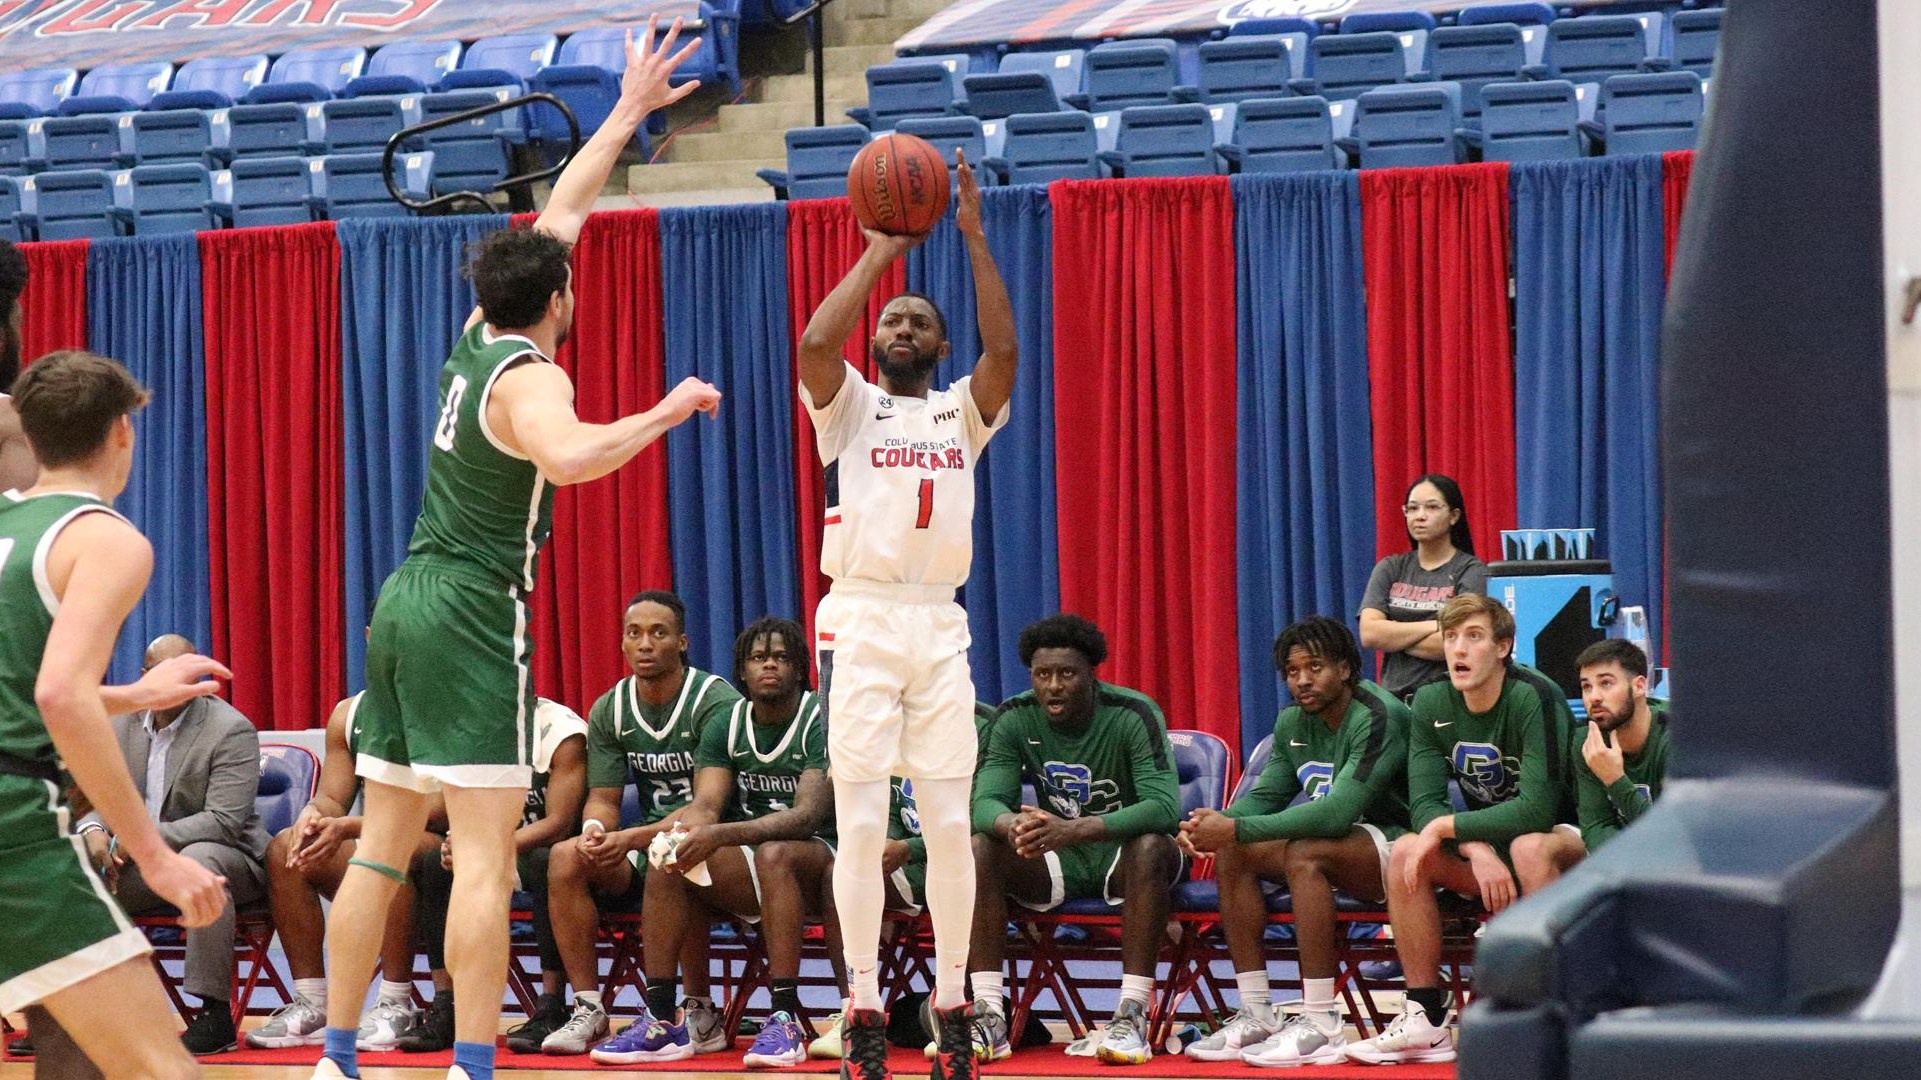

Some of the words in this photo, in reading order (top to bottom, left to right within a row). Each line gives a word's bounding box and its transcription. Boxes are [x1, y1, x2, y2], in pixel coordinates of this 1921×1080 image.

[873, 152, 896, 220] Wilson
[434, 374, 468, 452] 0
[934, 408, 960, 425] PBC
[915, 478, 934, 529] 1
[627, 751, 695, 773] GEORGIA
[737, 771, 800, 793] GEORGI
